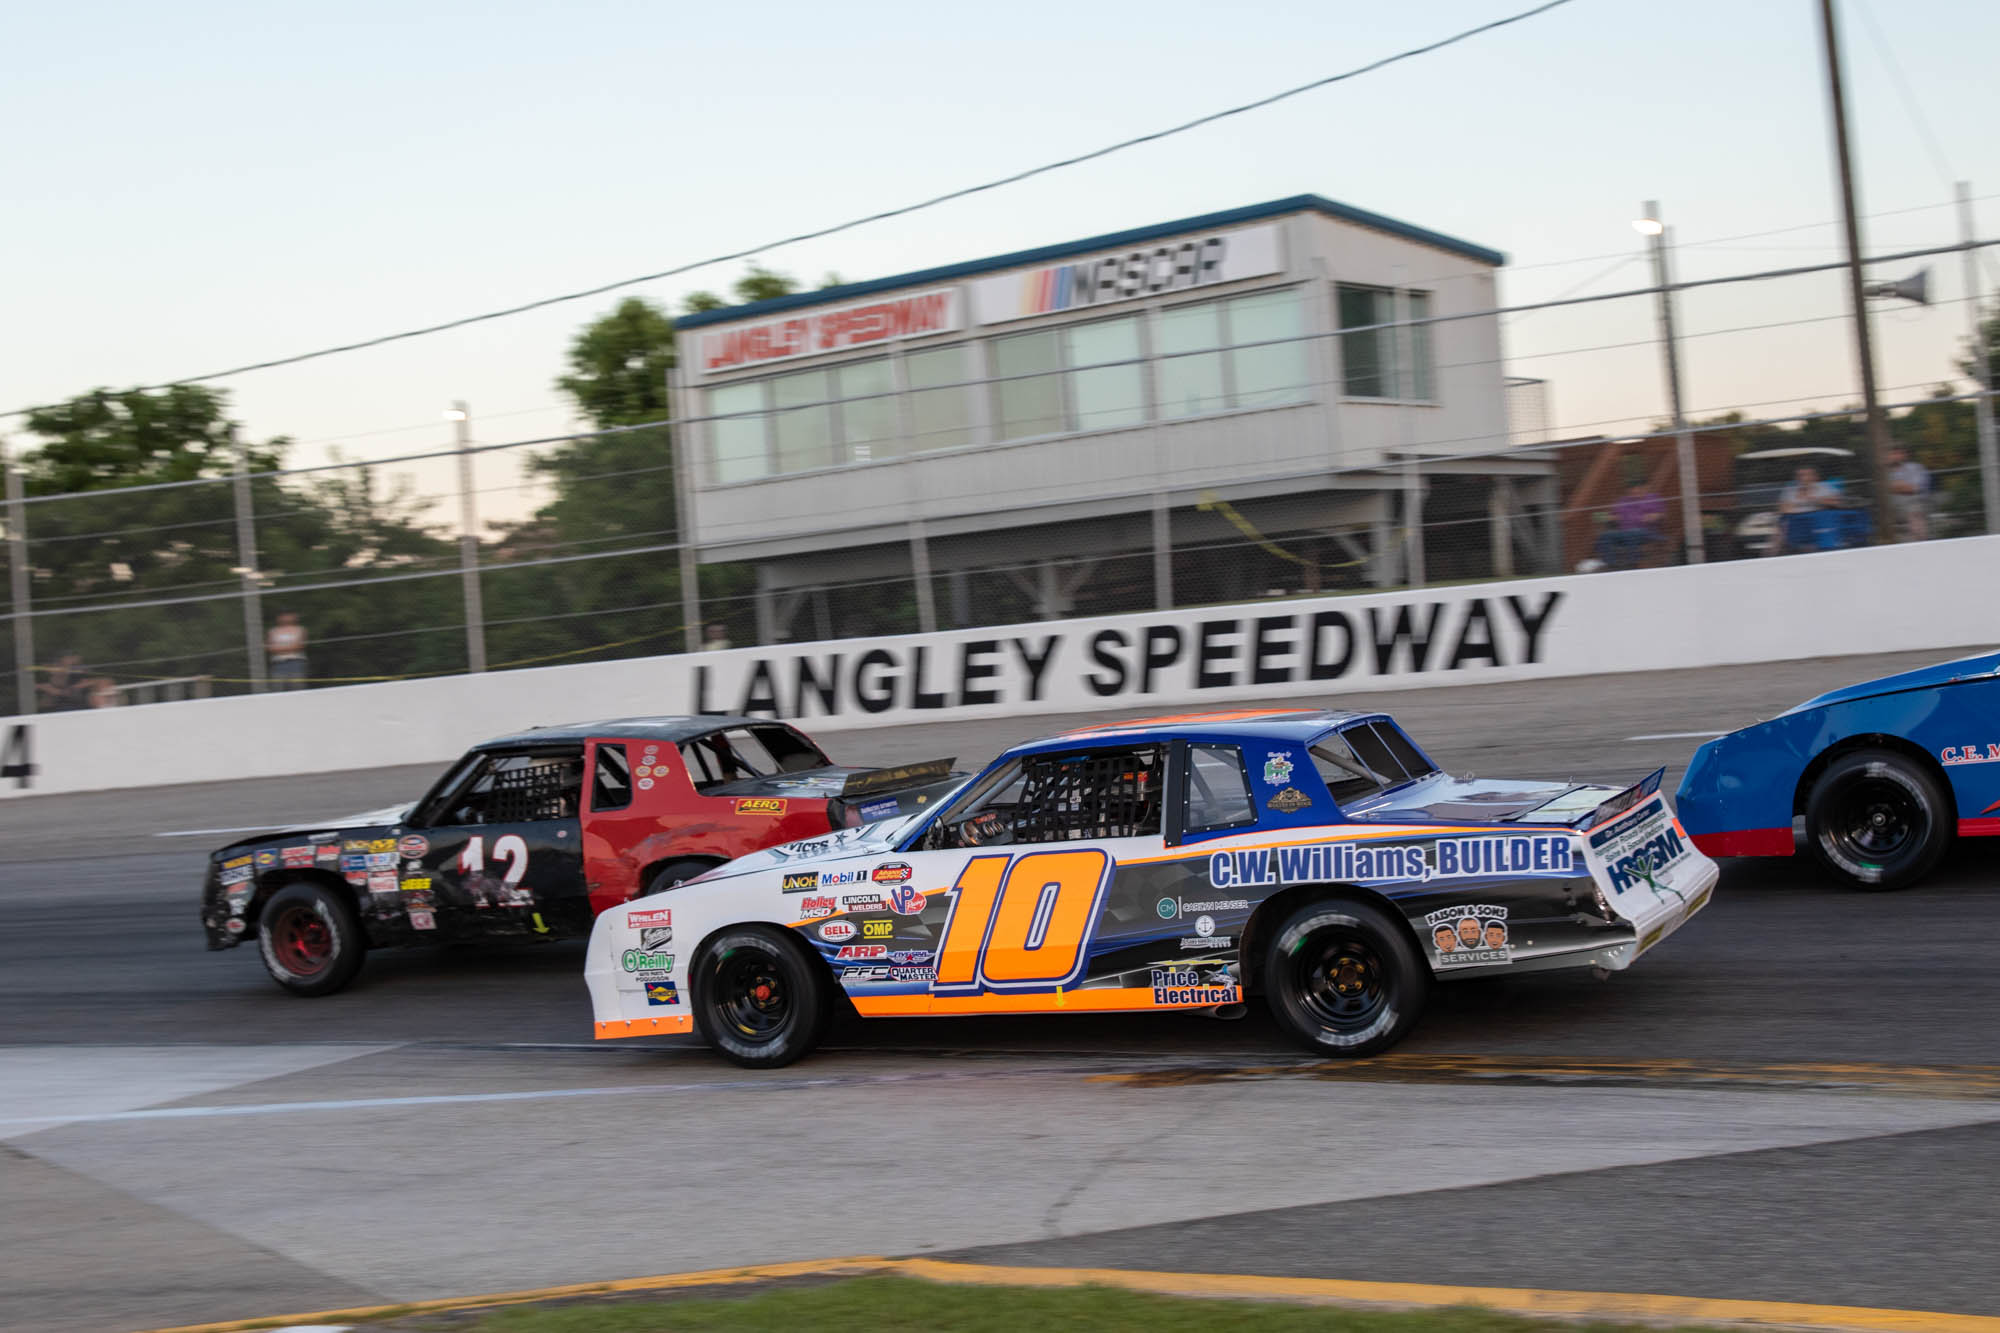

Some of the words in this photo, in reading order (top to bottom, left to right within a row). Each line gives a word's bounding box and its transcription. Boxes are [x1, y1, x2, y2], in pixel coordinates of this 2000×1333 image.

[1073, 238, 1227, 303] NASCAR
[695, 633, 1064, 718] LANGLEY
[1084, 592, 1561, 696] SPEEDWAY
[0, 724, 36, 789] 4
[1941, 745, 1984, 762] C.E.
[742, 799, 780, 810] AERO
[785, 840, 829, 853] VICES
[1209, 849, 1275, 887] C.W.
[1279, 843, 1434, 884] Williams,
[1435, 836, 1573, 875] BUILDER
[457, 834, 535, 908] 12
[783, 875, 818, 889] UNOH
[821, 872, 854, 884] Mobil
[801, 896, 837, 909] Holley
[843, 895, 879, 904] LINCOLN
[891, 885, 914, 914] VP
[800, 908, 831, 919] MSD
[852, 903, 883, 911] WELDERS
[933, 848, 1115, 994] 10
[1427, 907, 1465, 925] FAISON
[1477, 907, 1506, 918] SONS
[824, 925, 851, 935] BELL
[863, 923, 893, 936] OMP
[838, 945, 886, 958] ARP
[1441, 951, 1506, 963] SERVICES
[622, 949, 674, 972] O'Reilly
[843, 967, 889, 976] PFC
[891, 967, 934, 977] QUARTER
[1152, 967, 1198, 986] Price
[1153, 984, 1239, 1005] Electrical
